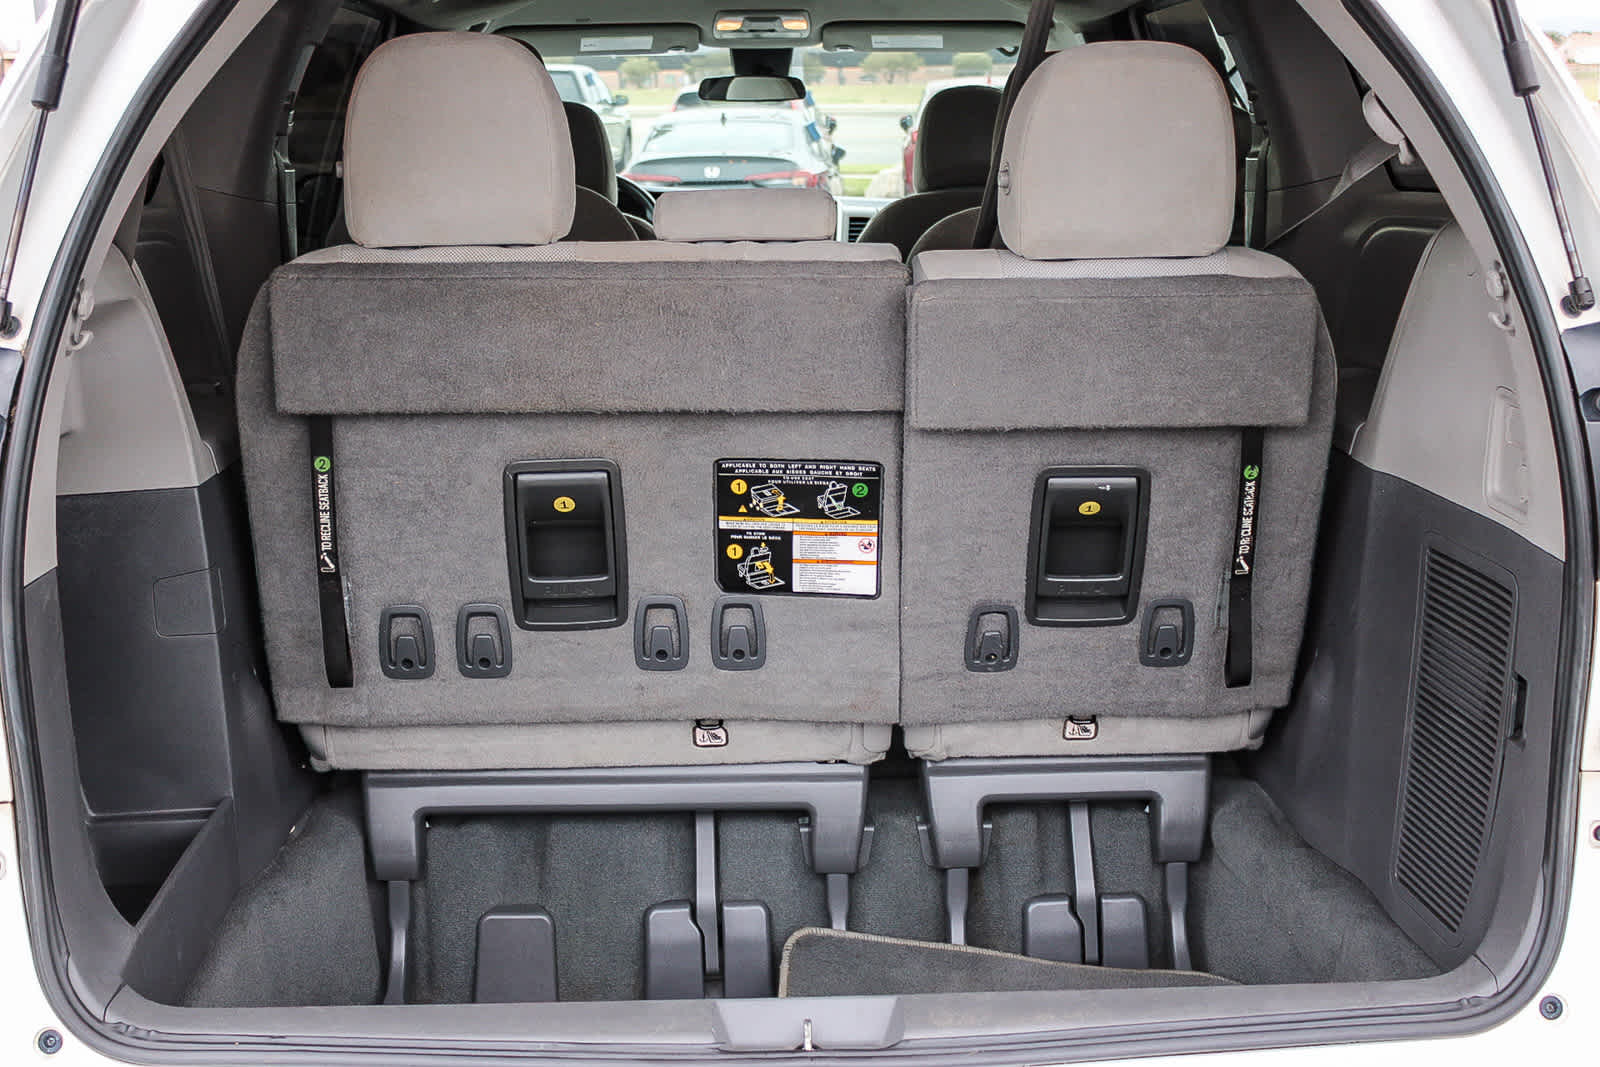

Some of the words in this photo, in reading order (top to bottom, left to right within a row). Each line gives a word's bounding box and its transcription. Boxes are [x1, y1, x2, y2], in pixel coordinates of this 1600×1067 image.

[317, 474, 330, 511] SEATBACK
[319, 511, 332, 543] RECLINE
[322, 542, 332, 551] TO
[1239, 545, 1250, 555] TO
